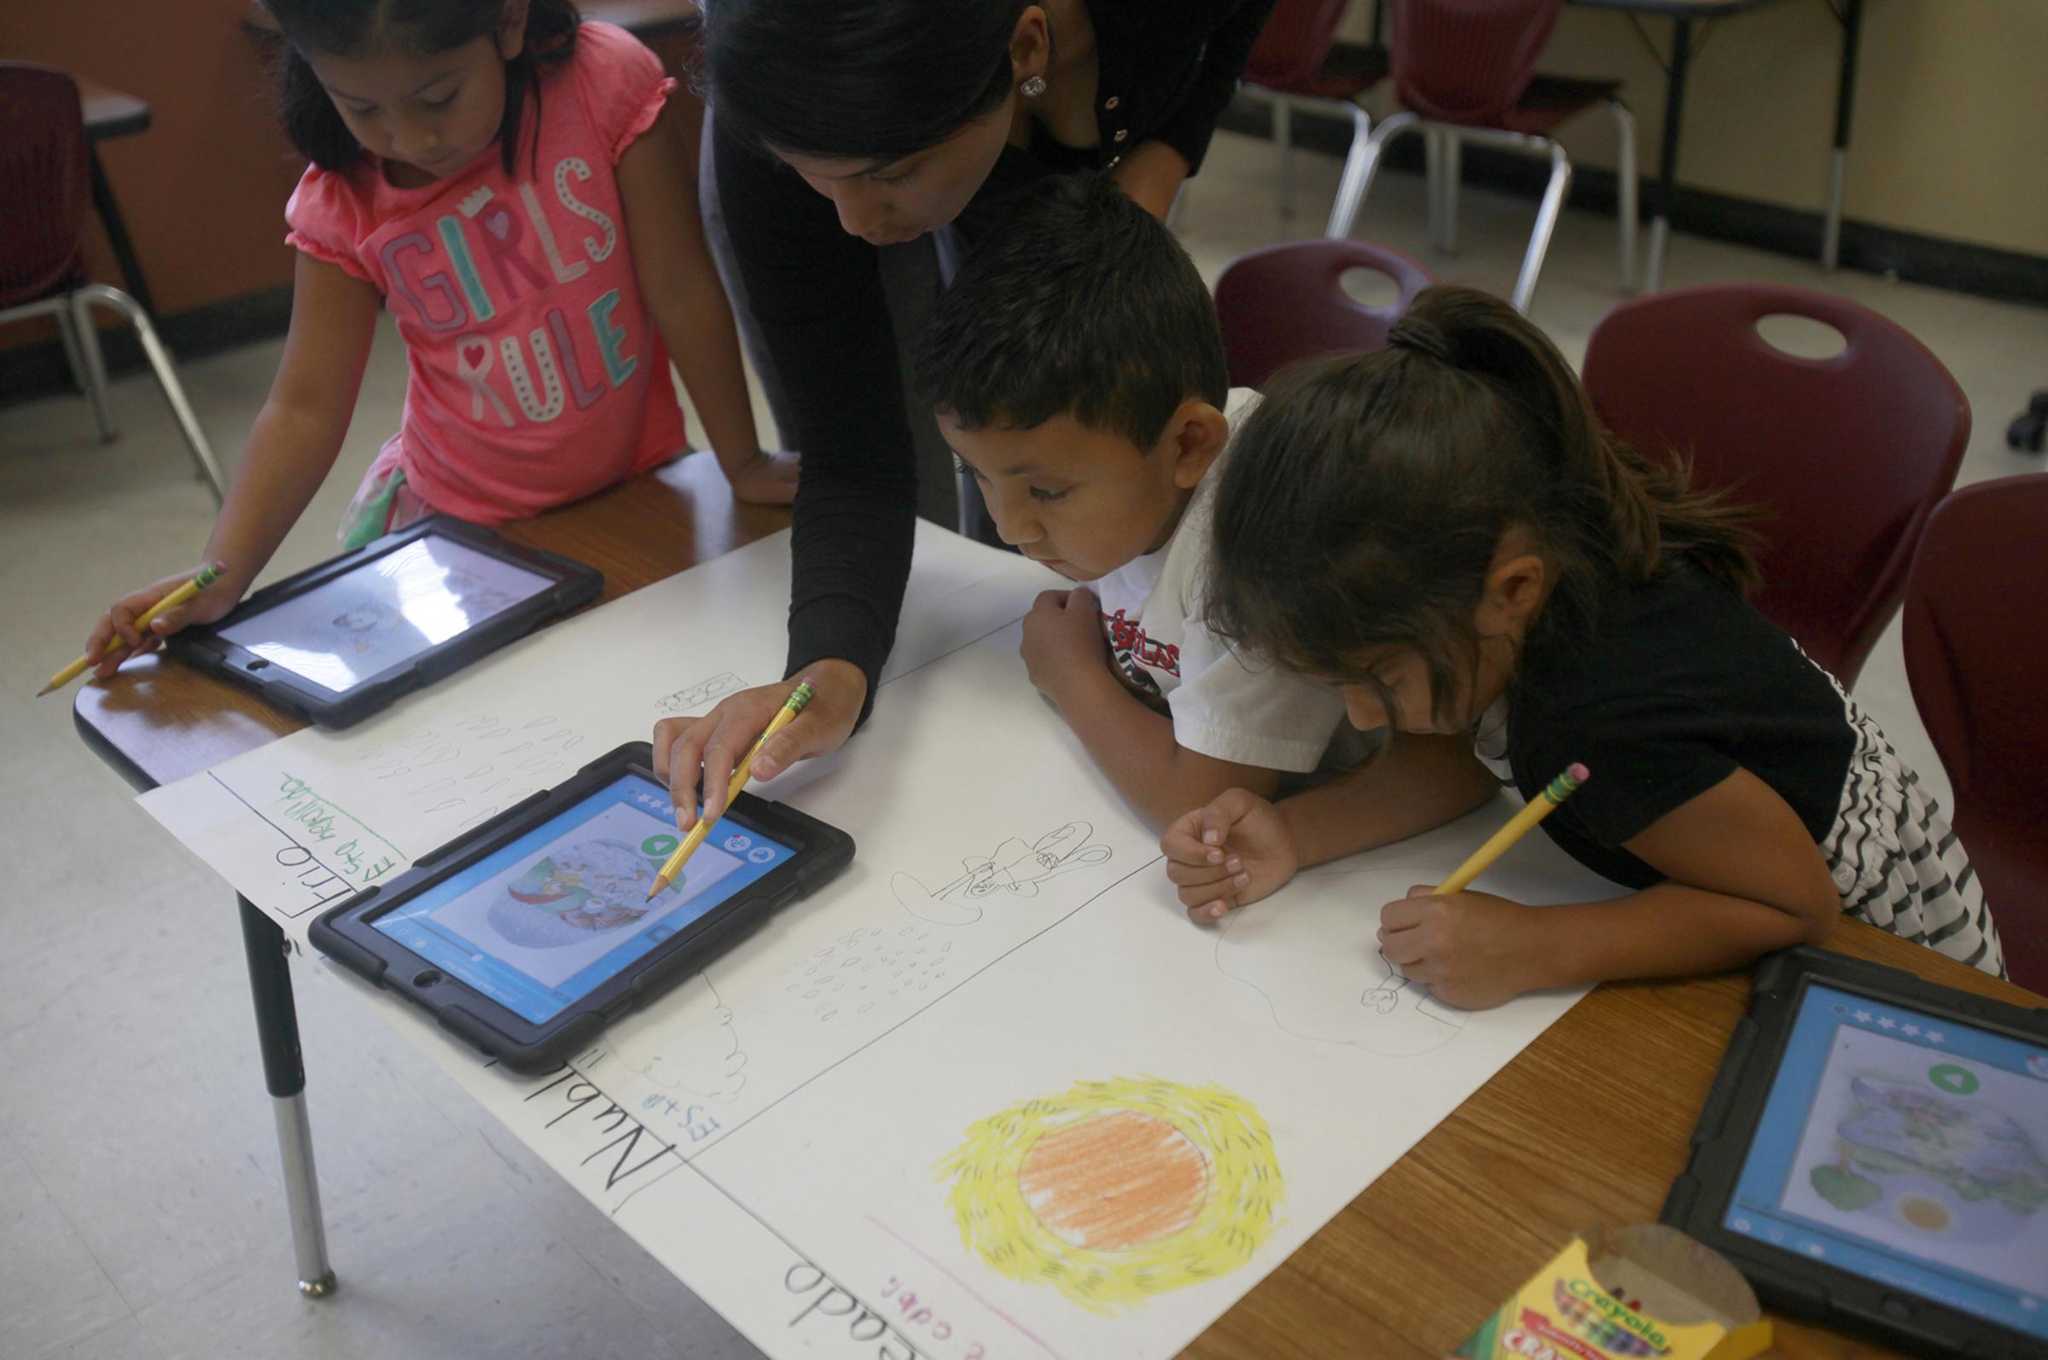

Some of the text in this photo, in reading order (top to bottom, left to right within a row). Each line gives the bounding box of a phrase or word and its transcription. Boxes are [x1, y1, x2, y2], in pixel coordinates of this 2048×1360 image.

[380, 155, 617, 333] GIRLS
[456, 288, 638, 428] RULE
[484, 1060, 677, 1192] Nubl
[1567, 1279, 1666, 1346] Crayola
